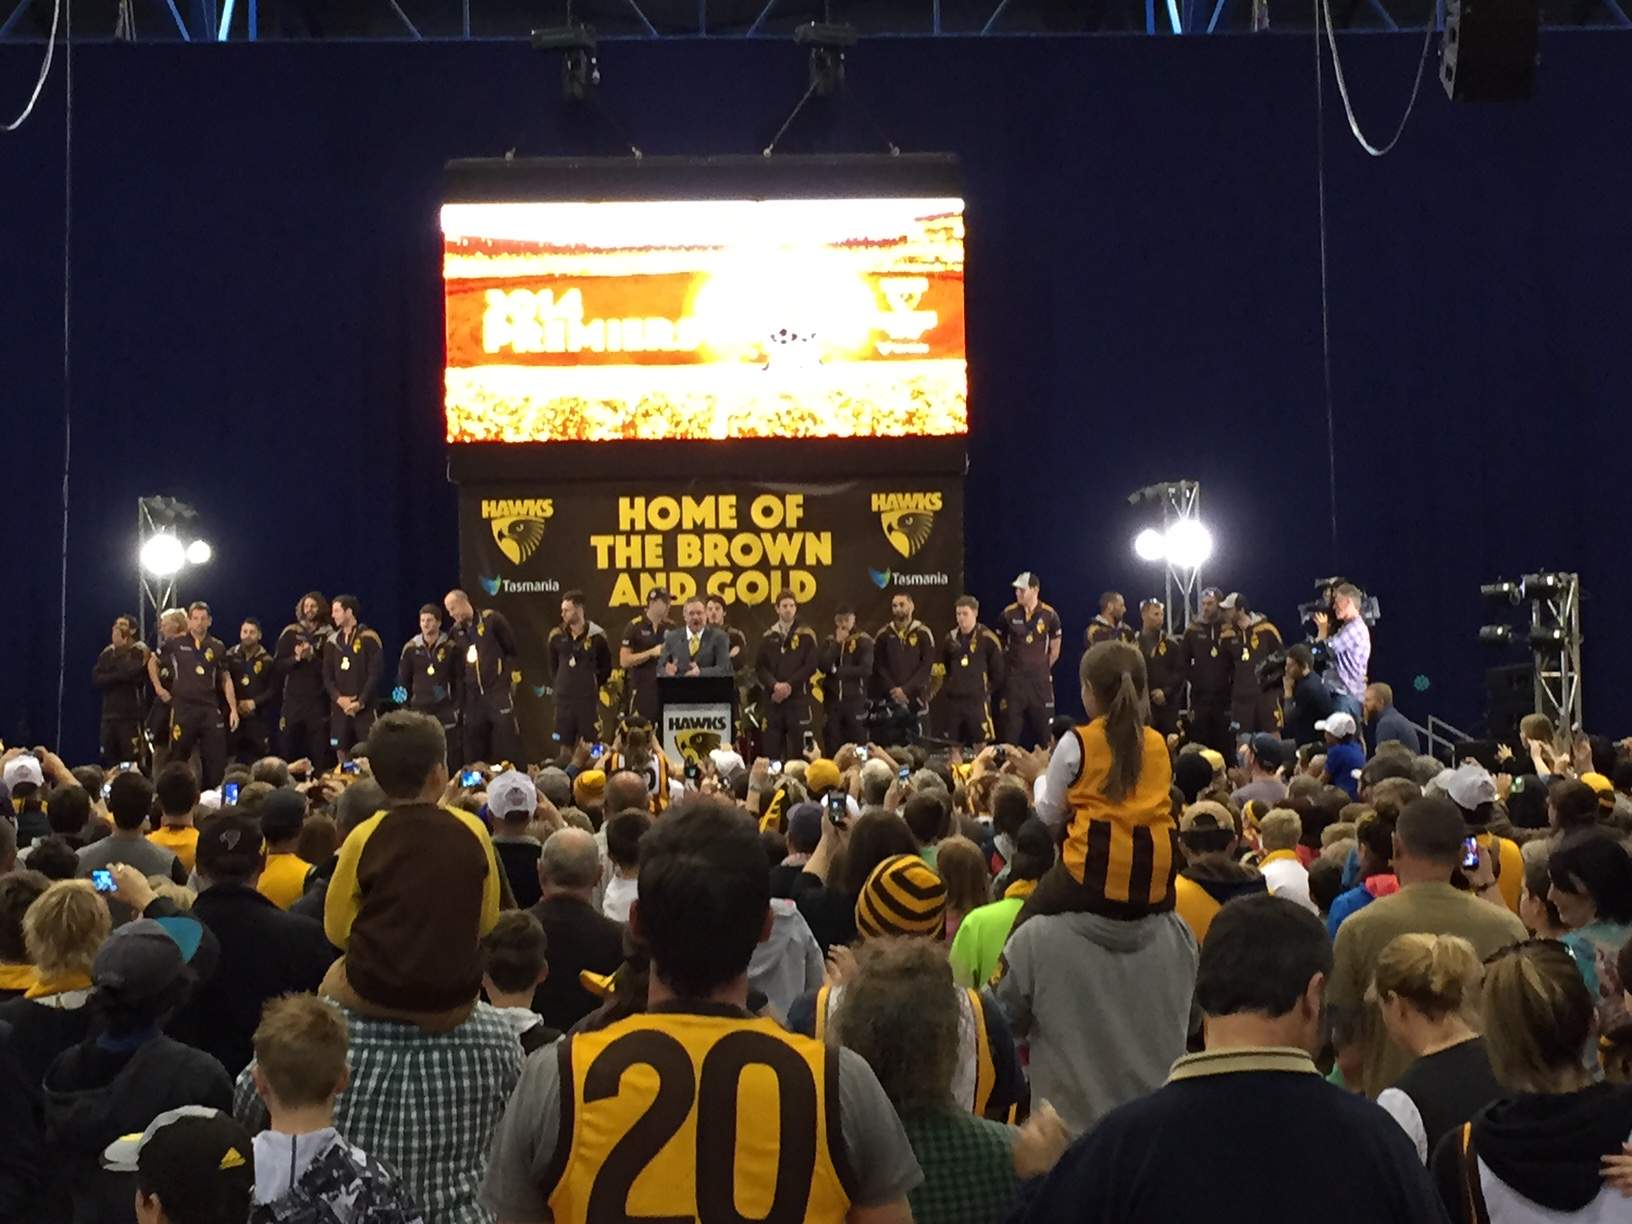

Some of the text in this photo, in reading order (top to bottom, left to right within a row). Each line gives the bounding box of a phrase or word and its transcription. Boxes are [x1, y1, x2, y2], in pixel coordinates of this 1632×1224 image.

[481, 498, 554, 518] HAWKS
[618, 493, 804, 531] HOME OF
[871, 491, 943, 512] HAWKS
[590, 531, 832, 569] THE BROWN
[503, 577, 560, 593] Tasmania
[608, 571, 697, 607] AND
[892, 571, 949, 586] Tasmania
[668, 716, 727, 731] HAWKS
[583, 1028, 817, 1224] 20
